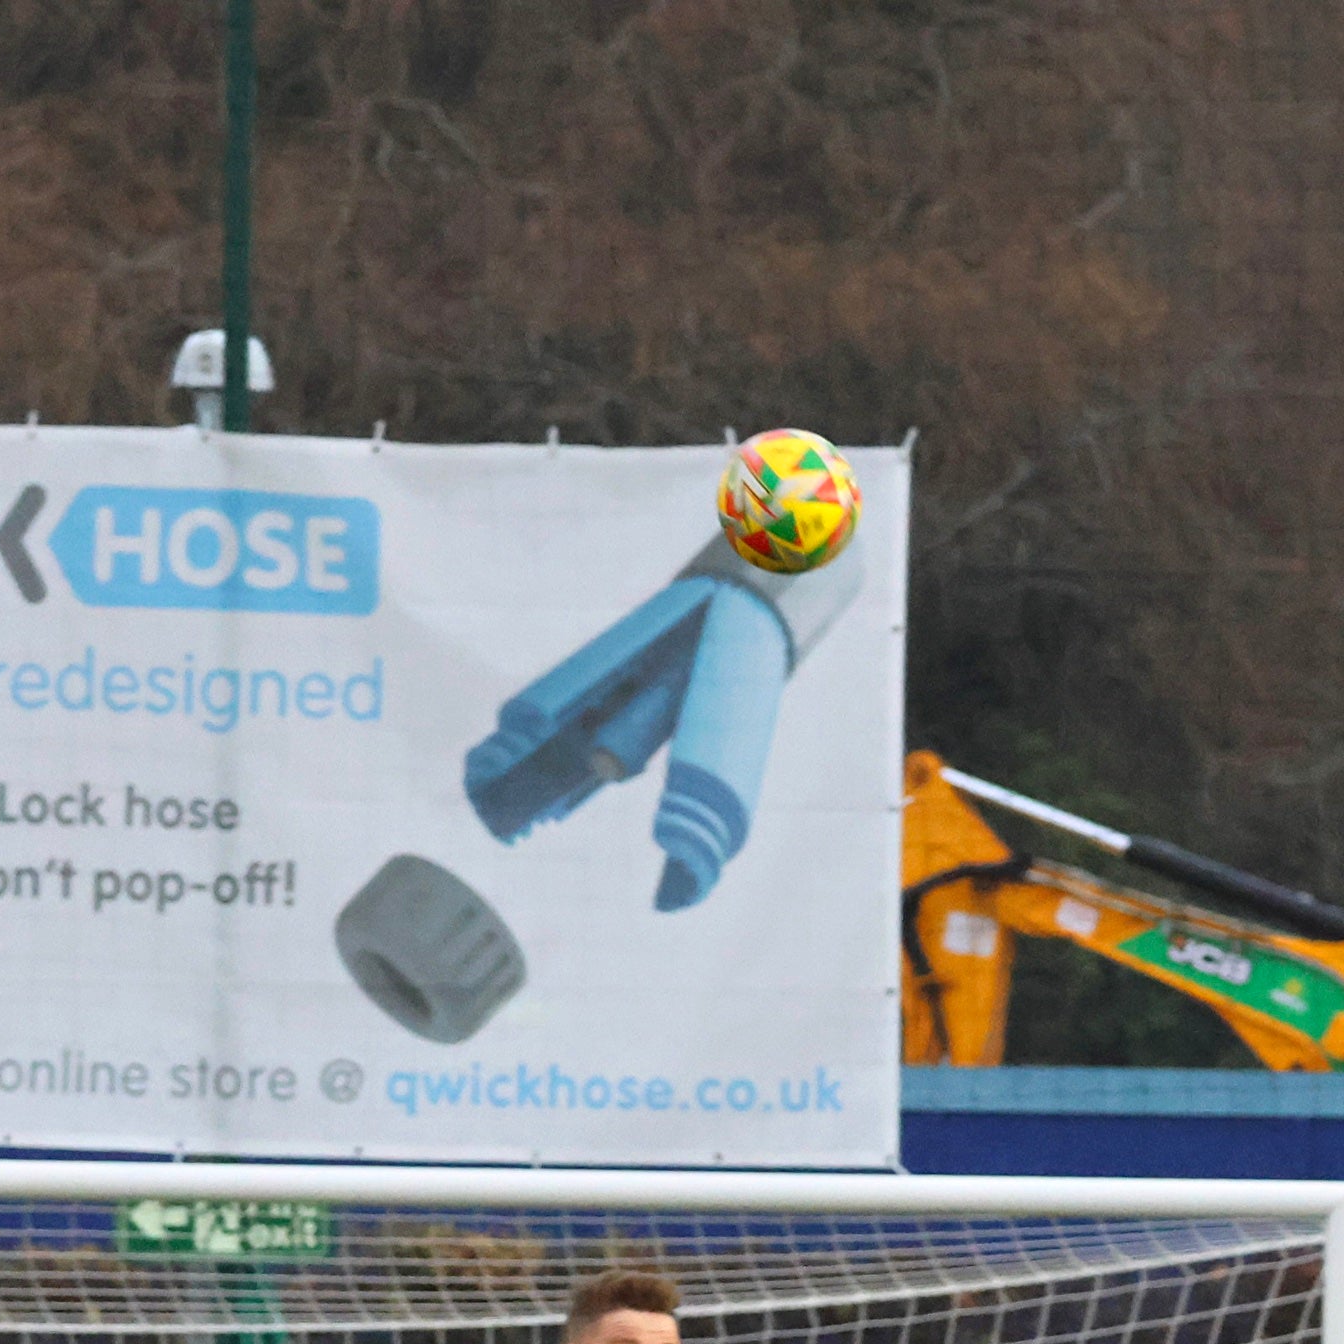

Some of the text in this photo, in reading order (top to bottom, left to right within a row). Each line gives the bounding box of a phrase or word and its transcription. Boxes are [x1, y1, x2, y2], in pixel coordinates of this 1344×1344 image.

[93, 505, 349, 593] HOSE
[124, 786, 240, 830] hose
[93, 859, 297, 913] pop-off!
[170, 1055, 297, 1101] store
[318, 1059, 364, 1103] @
[386, 1061, 844, 1114] qwickhose.co.uk
